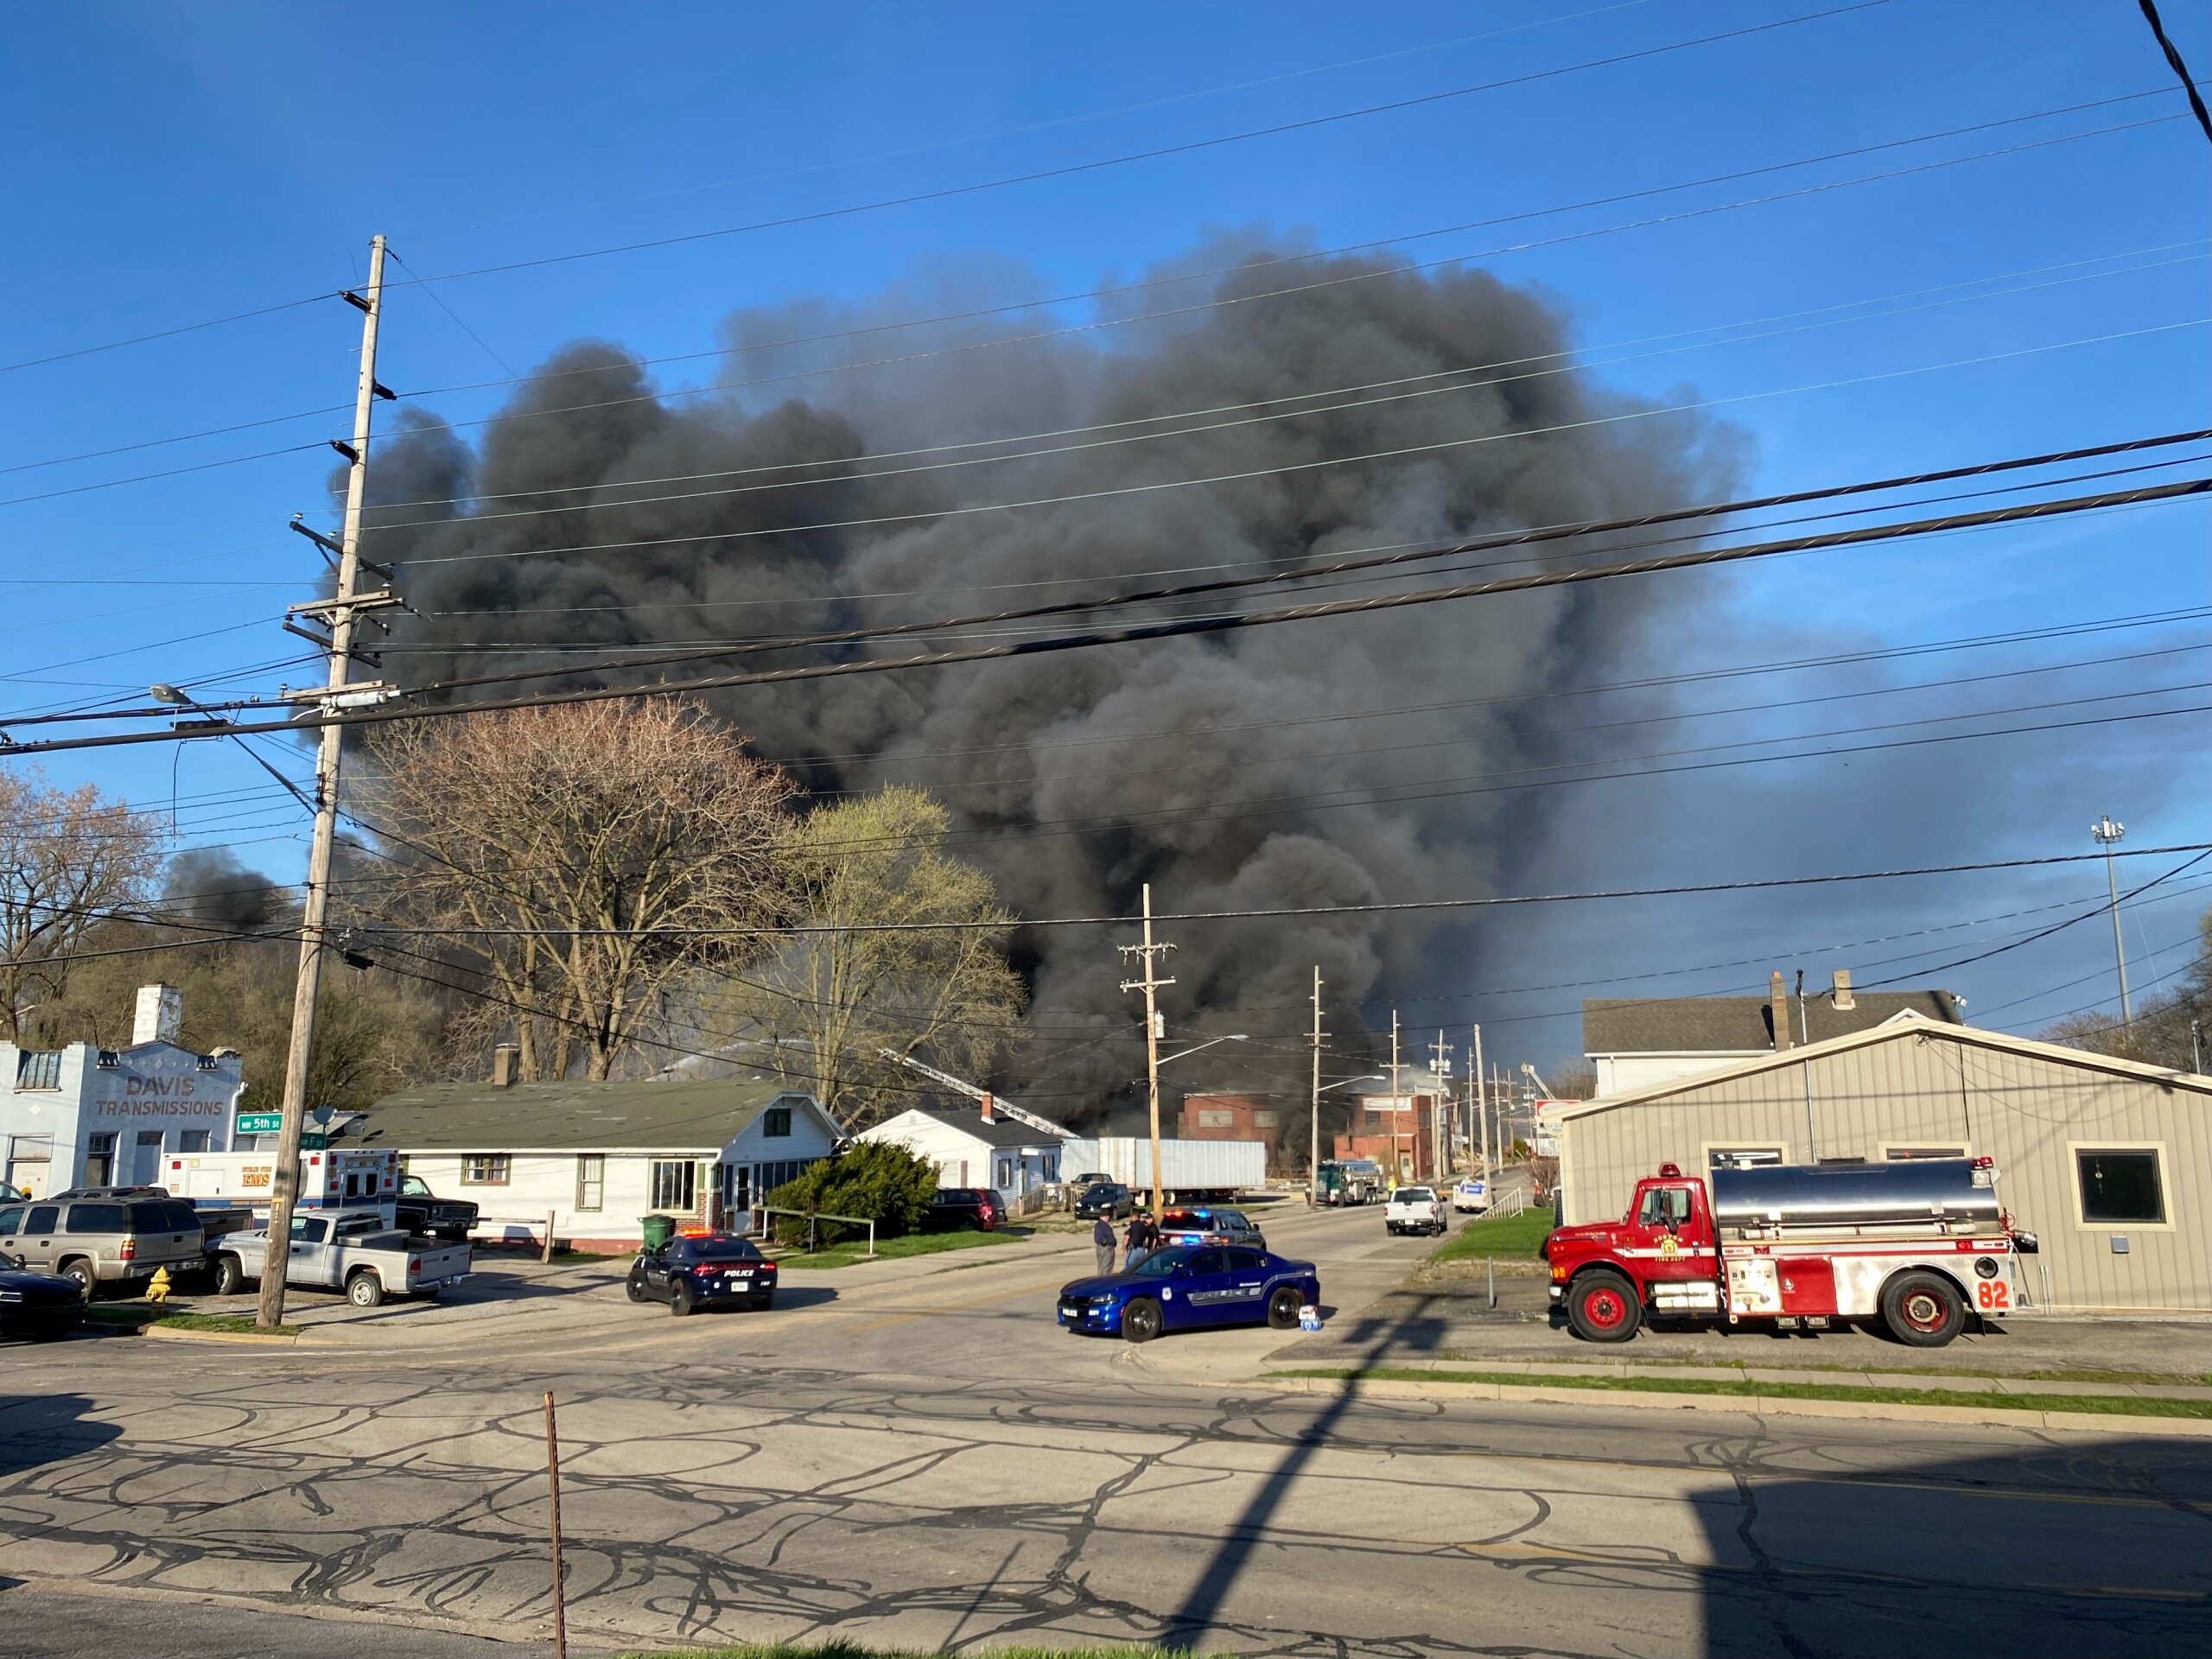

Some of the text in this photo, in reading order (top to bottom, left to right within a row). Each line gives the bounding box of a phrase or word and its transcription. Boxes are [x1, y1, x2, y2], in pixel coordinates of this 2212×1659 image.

[126, 1076, 194, 1096] DAVIS
[96, 1101, 222, 1116] TRANSMISSIONS
[254, 1118, 270, 1128] 5th
[242, 1173, 270, 1187] EMS
[1653, 1234, 1684, 1243] BOSTON
[1193, 1288, 1250, 1300] POLICE
[1979, 1281, 2009, 1308] 82
